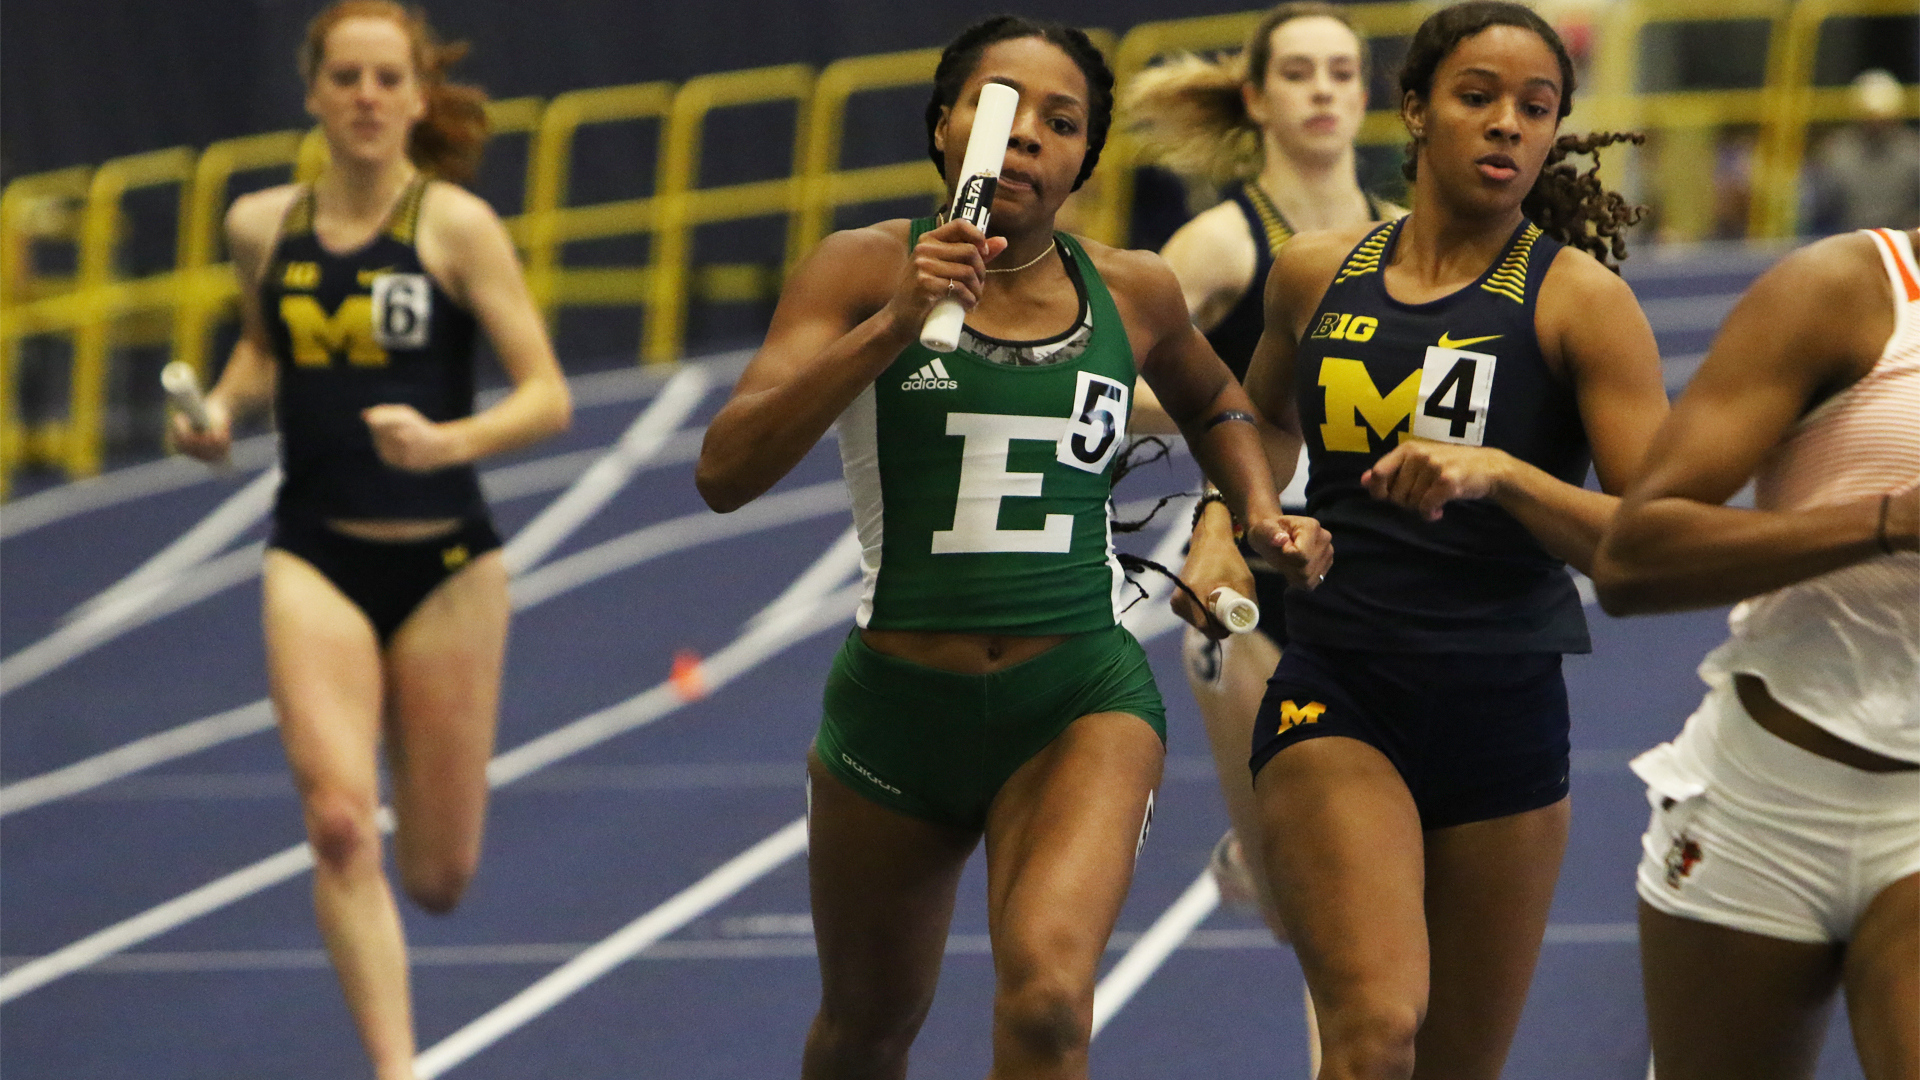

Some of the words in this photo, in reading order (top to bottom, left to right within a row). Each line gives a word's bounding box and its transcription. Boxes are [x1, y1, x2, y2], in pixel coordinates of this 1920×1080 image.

[962, 178, 984, 224] ELTA
[279, 294, 389, 369] M
[384, 281, 417, 337] 6
[1311, 312, 1379, 343] BIG
[901, 377, 958, 391] adidas
[1317, 356, 1424, 453] M
[1423, 356, 1478, 439] 4
[1071, 379, 1122, 464] 5
[931, 412, 1074, 554] E
[1276, 699, 1327, 735] M
